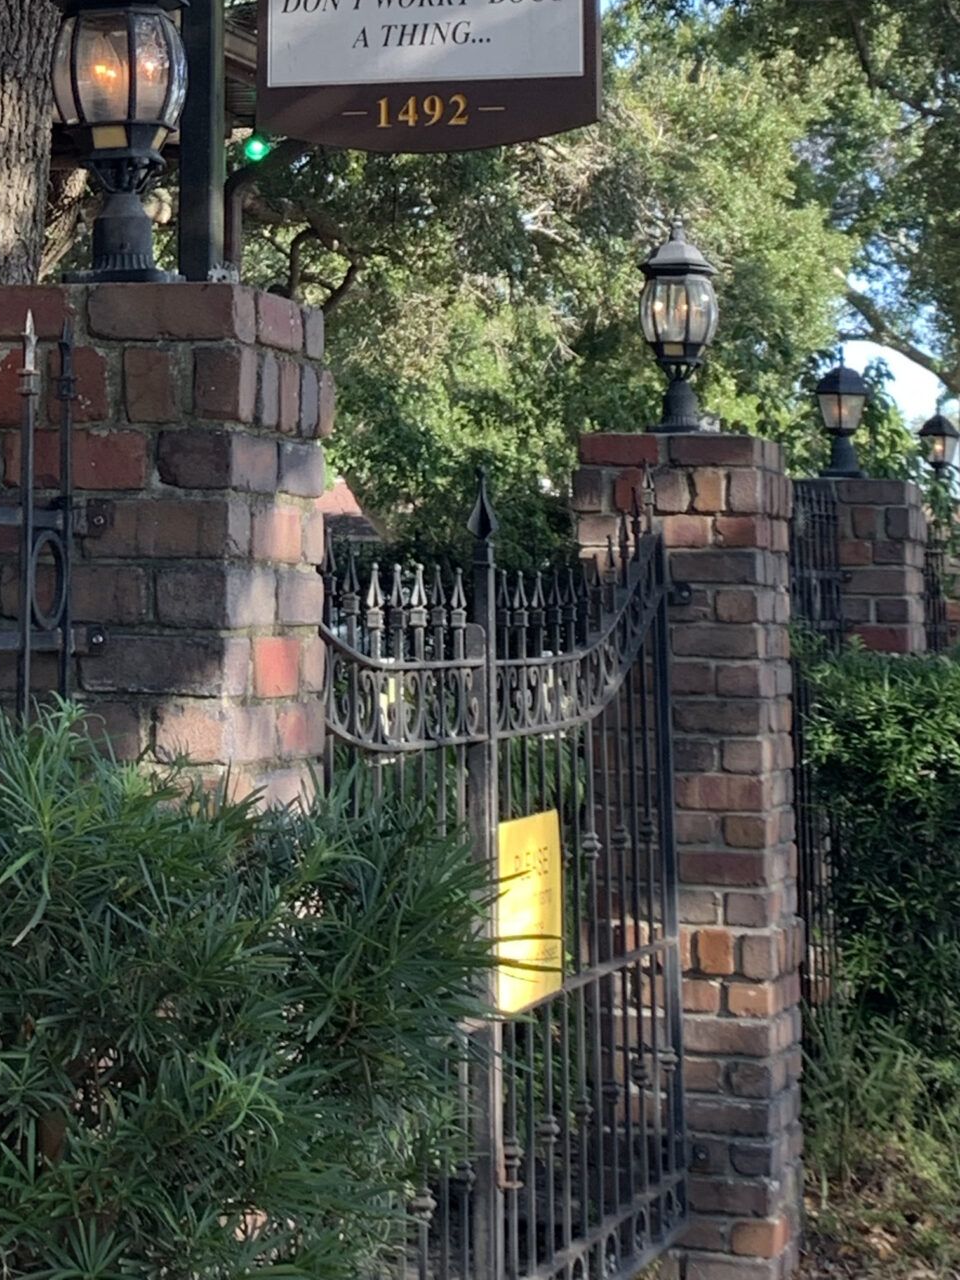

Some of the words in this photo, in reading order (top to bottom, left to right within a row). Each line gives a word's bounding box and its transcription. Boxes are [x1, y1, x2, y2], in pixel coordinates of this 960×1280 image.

[352, 26, 370, 49] A
[381, 21, 492, 48] THING...
[376, 93, 470, 129] 1492
